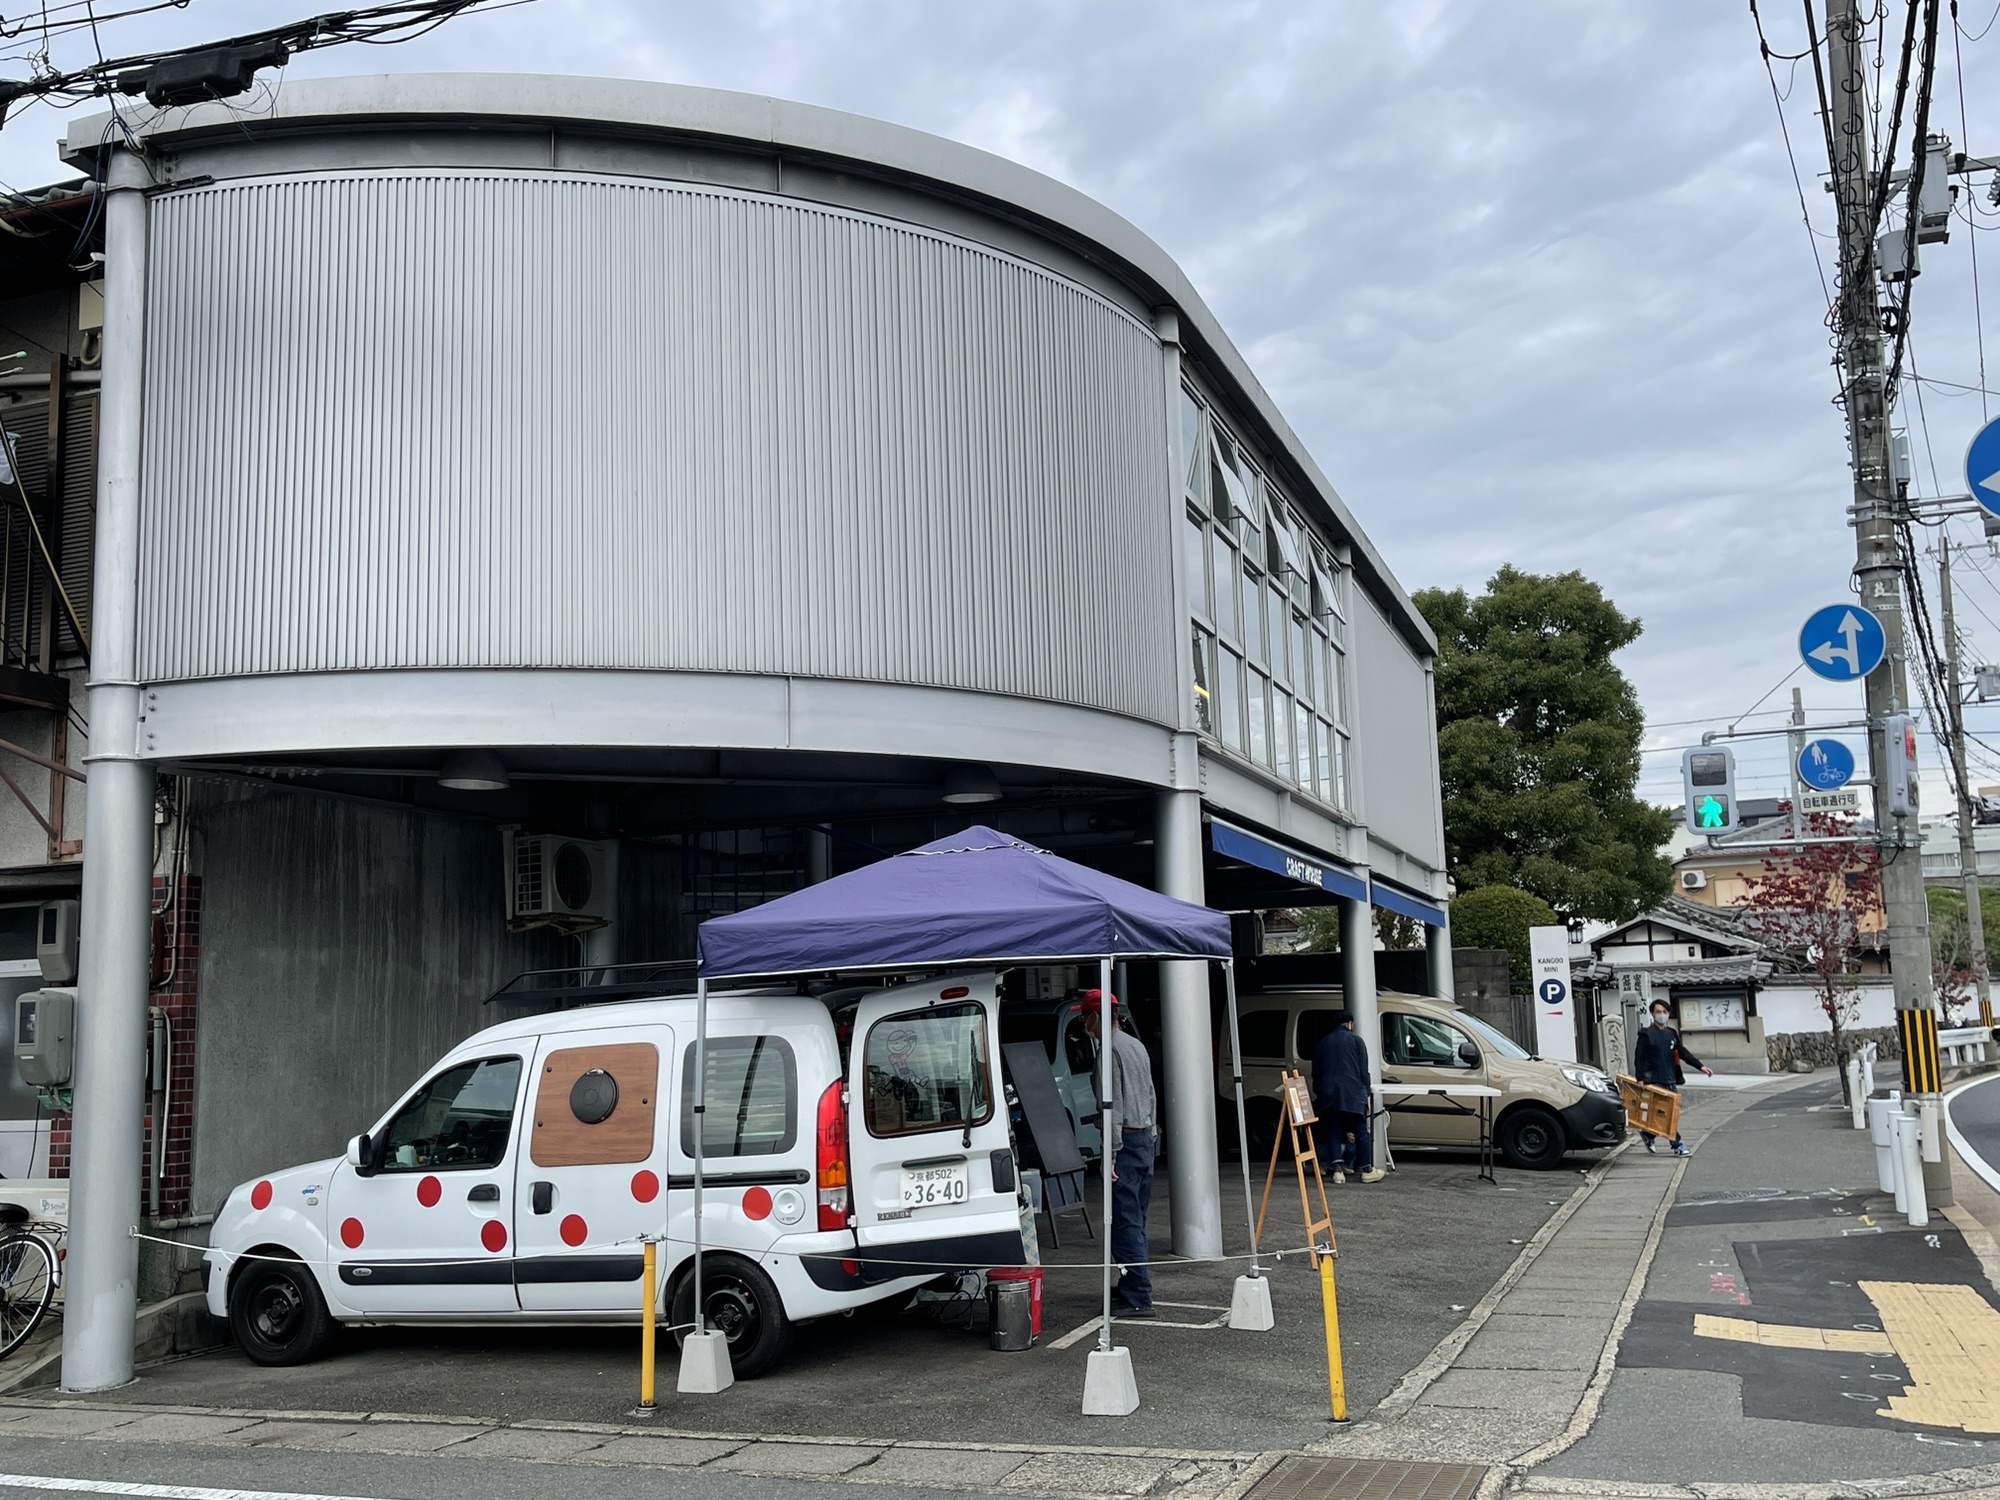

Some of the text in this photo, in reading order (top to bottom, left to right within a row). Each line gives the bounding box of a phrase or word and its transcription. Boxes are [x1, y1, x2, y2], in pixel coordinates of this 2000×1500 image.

[1803, 793, 1855, 809] 自転車通行可
[1537, 957, 1564, 965] KANGOO
[1546, 983, 1561, 1000] P
[904, 1180, 964, 1204] ひ 36-40
